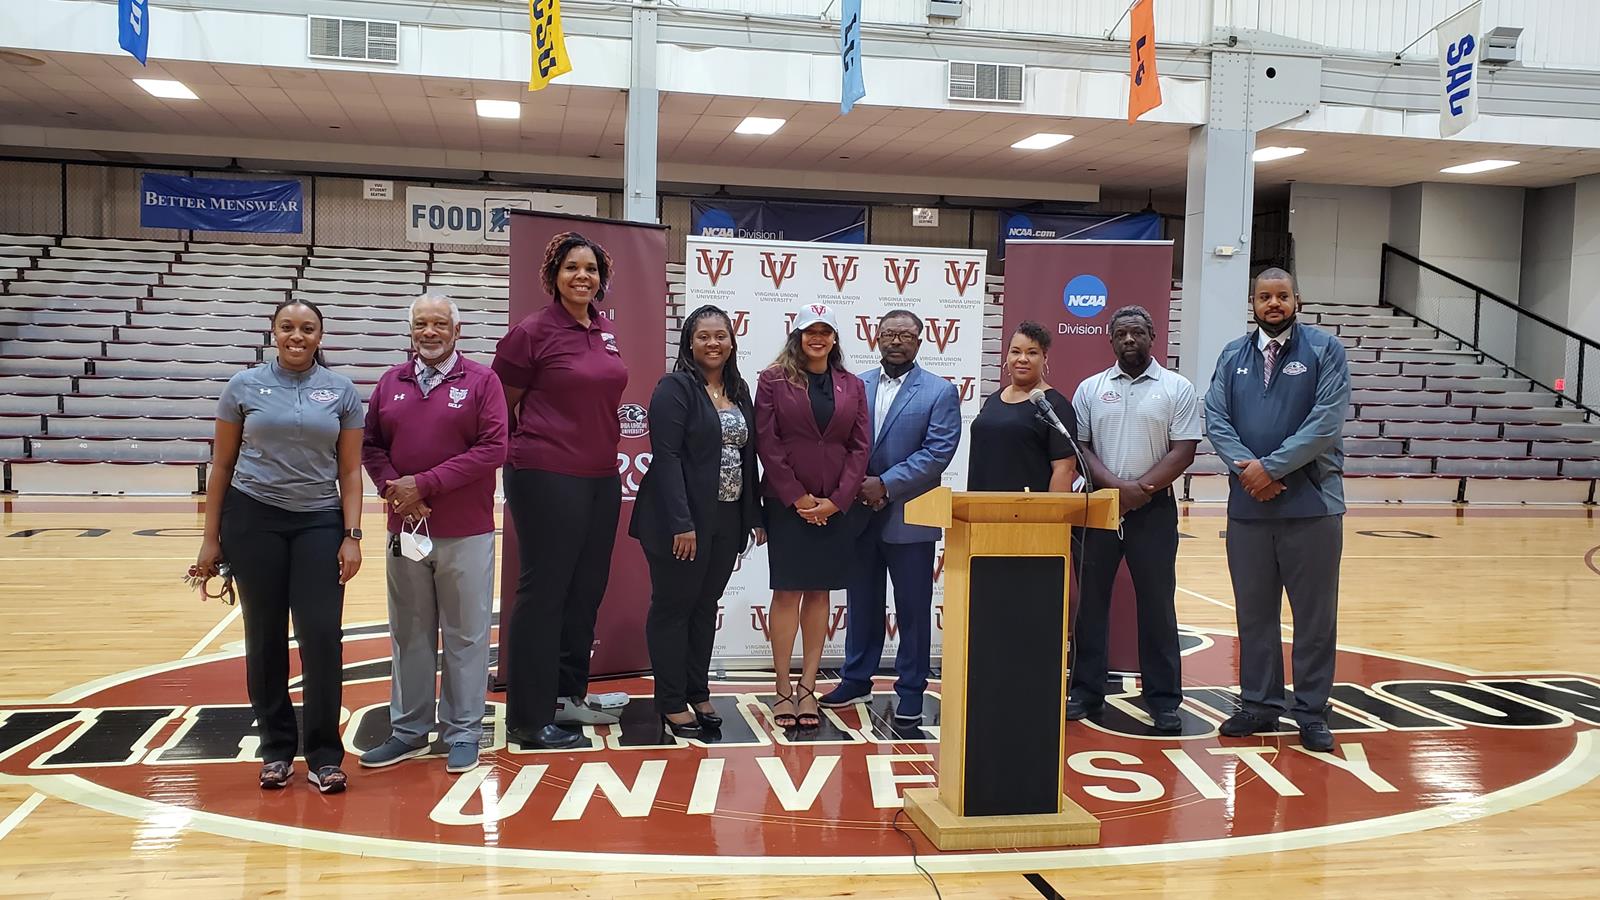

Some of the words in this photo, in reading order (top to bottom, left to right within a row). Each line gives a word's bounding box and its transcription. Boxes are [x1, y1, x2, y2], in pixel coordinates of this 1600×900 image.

[145, 191, 207, 209] BETTER
[210, 197, 299, 212] MENSWEAR
[412, 204, 482, 231] FOOD
[702, 227, 734, 238] NCAA
[738, 228, 776, 240] Division
[1008, 228, 1056, 238] NCAA.com
[1067, 295, 1106, 307] NCAA
[1058, 323, 1103, 335] Division
[429, 742, 1400, 827] UNIVESITY
